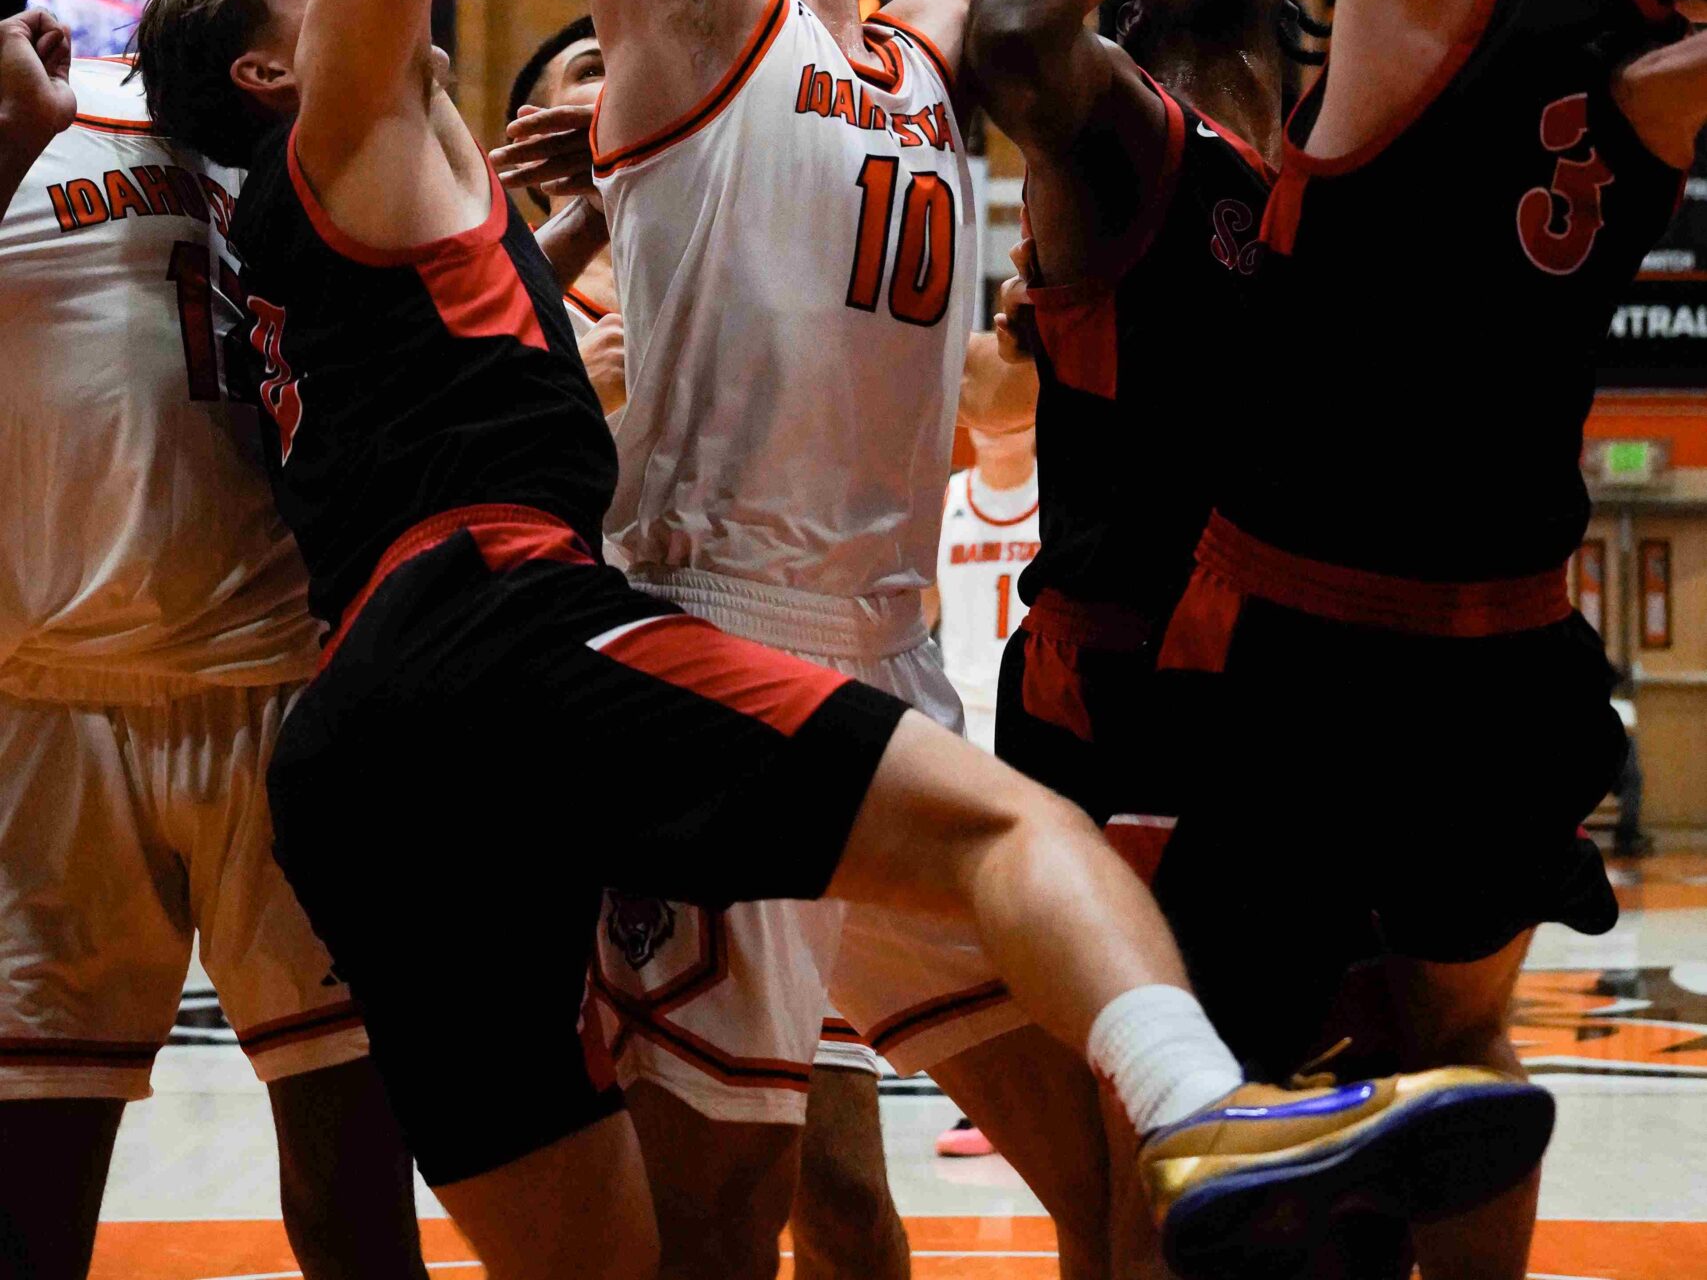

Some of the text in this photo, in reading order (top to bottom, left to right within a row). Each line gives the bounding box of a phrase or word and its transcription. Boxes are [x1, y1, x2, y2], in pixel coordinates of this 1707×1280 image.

[795, 63, 893, 131] IDAH
[47, 165, 211, 233] IDAHO
[845, 153, 956, 327] 10
[996, 573, 1011, 639] 1
